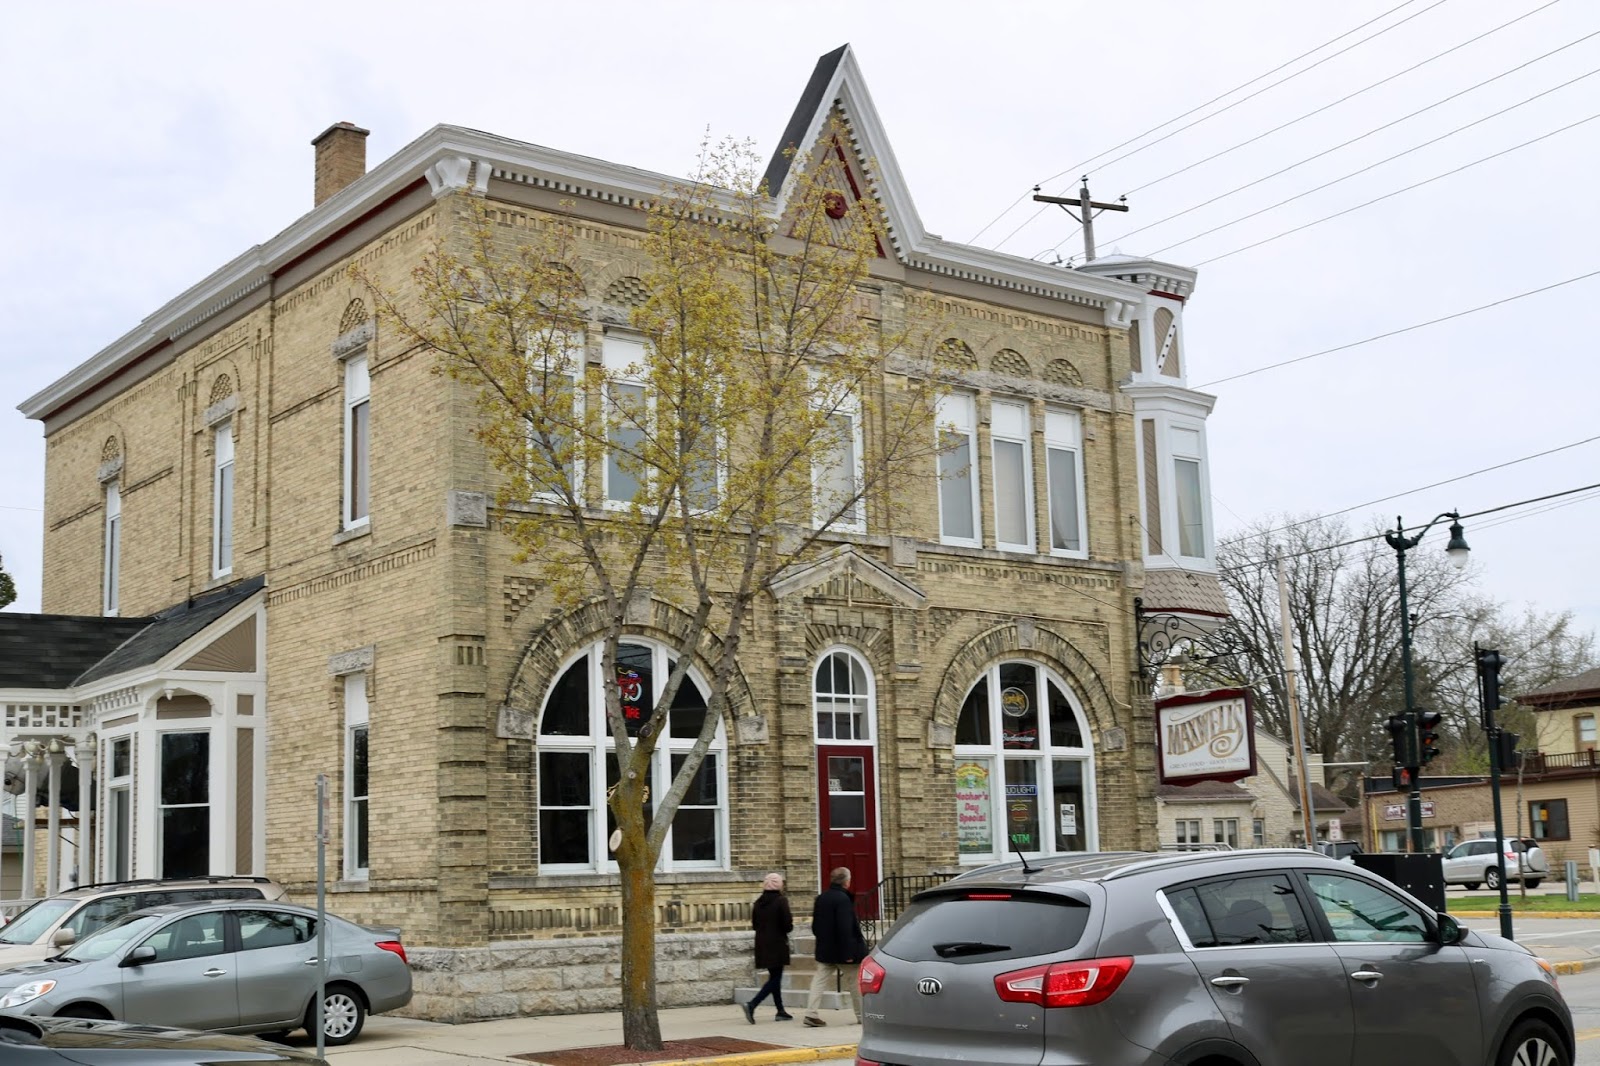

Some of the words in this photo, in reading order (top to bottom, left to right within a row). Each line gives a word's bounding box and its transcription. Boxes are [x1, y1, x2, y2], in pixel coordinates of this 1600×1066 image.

[965, 802, 980, 815] Day
[1012, 833, 1031, 844] ATM
[919, 981, 937, 993] KIA
